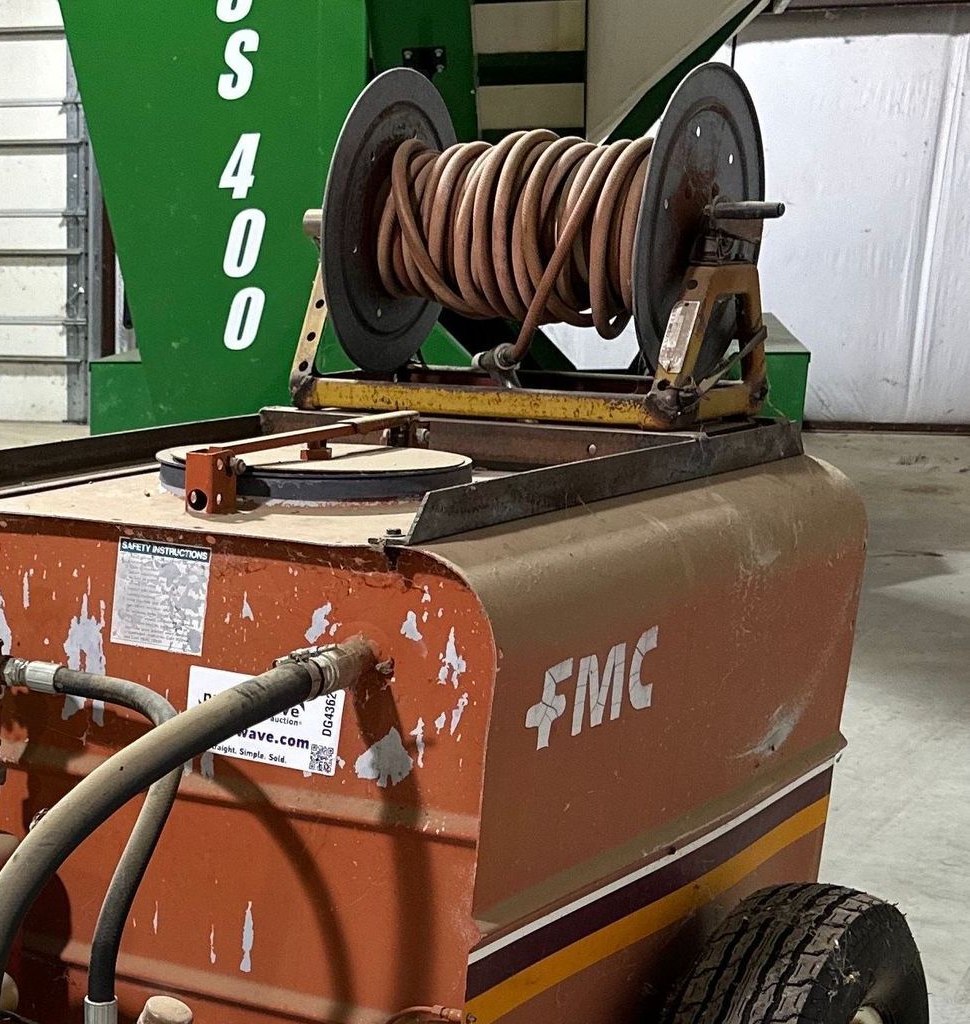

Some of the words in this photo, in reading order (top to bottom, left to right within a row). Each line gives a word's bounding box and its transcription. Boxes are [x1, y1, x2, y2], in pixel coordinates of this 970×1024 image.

[218, 133, 265, 350] 400
[121, 540, 151, 553] SAFETY
[152, 545, 208, 560] INSTRUCTIONS
[525, 625, 659, 750] FMC
